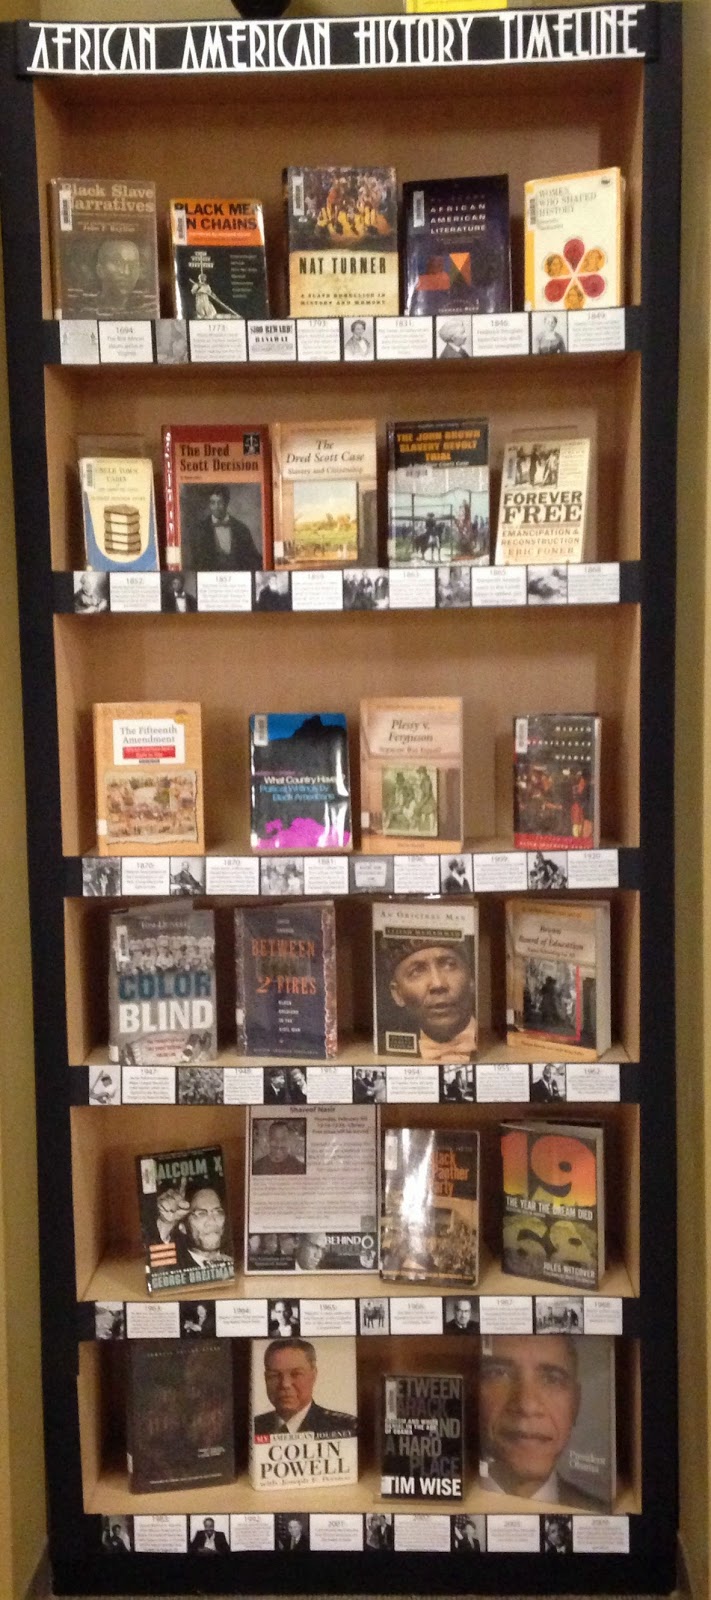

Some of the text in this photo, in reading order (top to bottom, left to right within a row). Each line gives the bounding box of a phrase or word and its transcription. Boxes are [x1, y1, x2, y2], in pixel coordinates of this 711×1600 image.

[31, 8, 638, 70] AFRICAN AMERICAN HISTORY TIMELINE
[112, 184, 155, 199] Slave
[430, 203, 486, 213] AFRICAN
[201, 217, 258, 231] CHAINS
[430, 214, 486, 224] AMERICAN
[430, 224, 486, 235] LITERATURE
[299, 256, 387, 274] NAT TURNER
[396, 430, 481, 442] THE JOHN BROWN
[180, 443, 230, 457] The Dred
[315, 439, 334, 450] The
[399, 440, 478, 453] SLAVERY REVOLT
[179, 459, 259, 471] Scott Decision
[286, 452, 365, 464] Dred Scott Case
[503, 490, 583, 505] FOREVER
[502, 503, 582, 524] FREE
[502, 529, 570, 537] EMANCIPATION
[501, 537, 580, 546] RECONSTRUCTION
[507, 547, 574, 556] ERIC FONER
[120, 725, 178, 735] The Fifteenth
[391, 719, 421, 731] Plessy
[122, 735, 175, 744] Amendment
[388, 731, 433, 744] Ferguson
[263, 776, 285, 784] What
[285, 775, 316, 785] Country
[251, 938, 315, 958] BETWEEN
[548, 938, 584, 950] Education
[118, 972, 212, 1001] COLOR
[255, 975, 317, 995] 2 FIRES
[119, 1000, 213, 1033] BLIND
[156, 1155, 223, 1180] ALCOLM X
[500, 1130, 597, 1208] 19
[505, 1196, 518, 1208] THE
[520, 1199, 537, 1211] YEAR
[538, 1202, 550, 1213] THE
[551, 1204, 577, 1218] DREAM
[577, 1208, 593, 1221] DIED
[325, 1235, 362, 1245] BEHIND
[151, 1265, 235, 1289] GEORGE BREITMAN
[396, 1377, 460, 1400] ETWEEN
[272, 1433, 313, 1441] AMERICAN
[315, 1431, 352, 1439] JOURNEY
[268, 1441, 341, 1462] COLIN
[399, 1436, 442, 1457] HARD
[260, 1458, 350, 1479] POWELL
[419, 1477, 462, 1496] WISE
